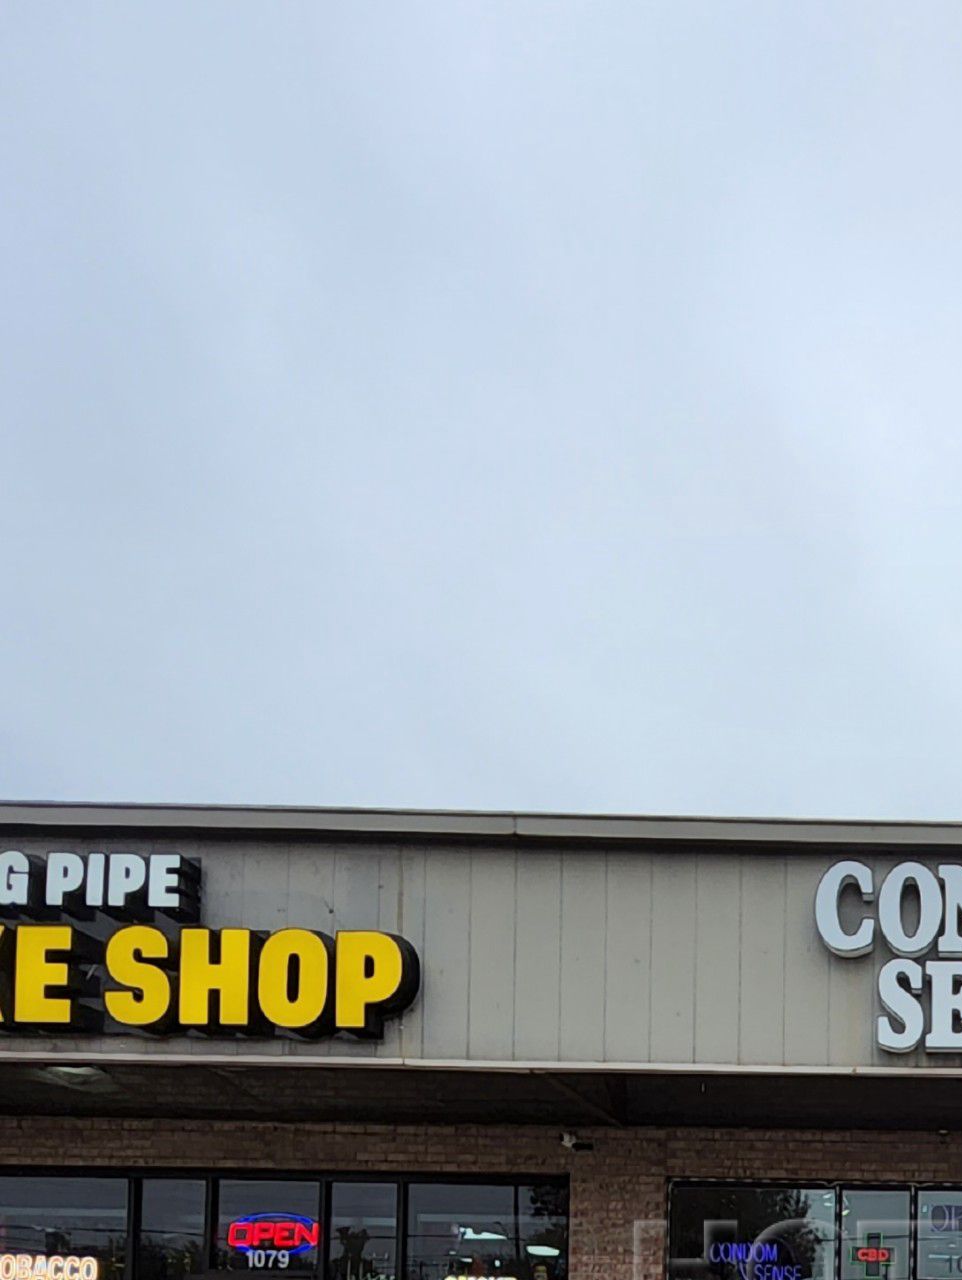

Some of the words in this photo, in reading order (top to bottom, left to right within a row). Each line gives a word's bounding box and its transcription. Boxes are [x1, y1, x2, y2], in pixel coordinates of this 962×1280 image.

[46, 852, 181, 907] PIPE
[0, 925, 72, 1023] E
[104, 925, 402, 1027] SHOP
[228, 1222, 319, 1247] OPEN
[246, 1249, 289, 1268] 1079
[710, 1242, 778, 1263] CONDOM
[857, 1249, 889, 1262] CBD
